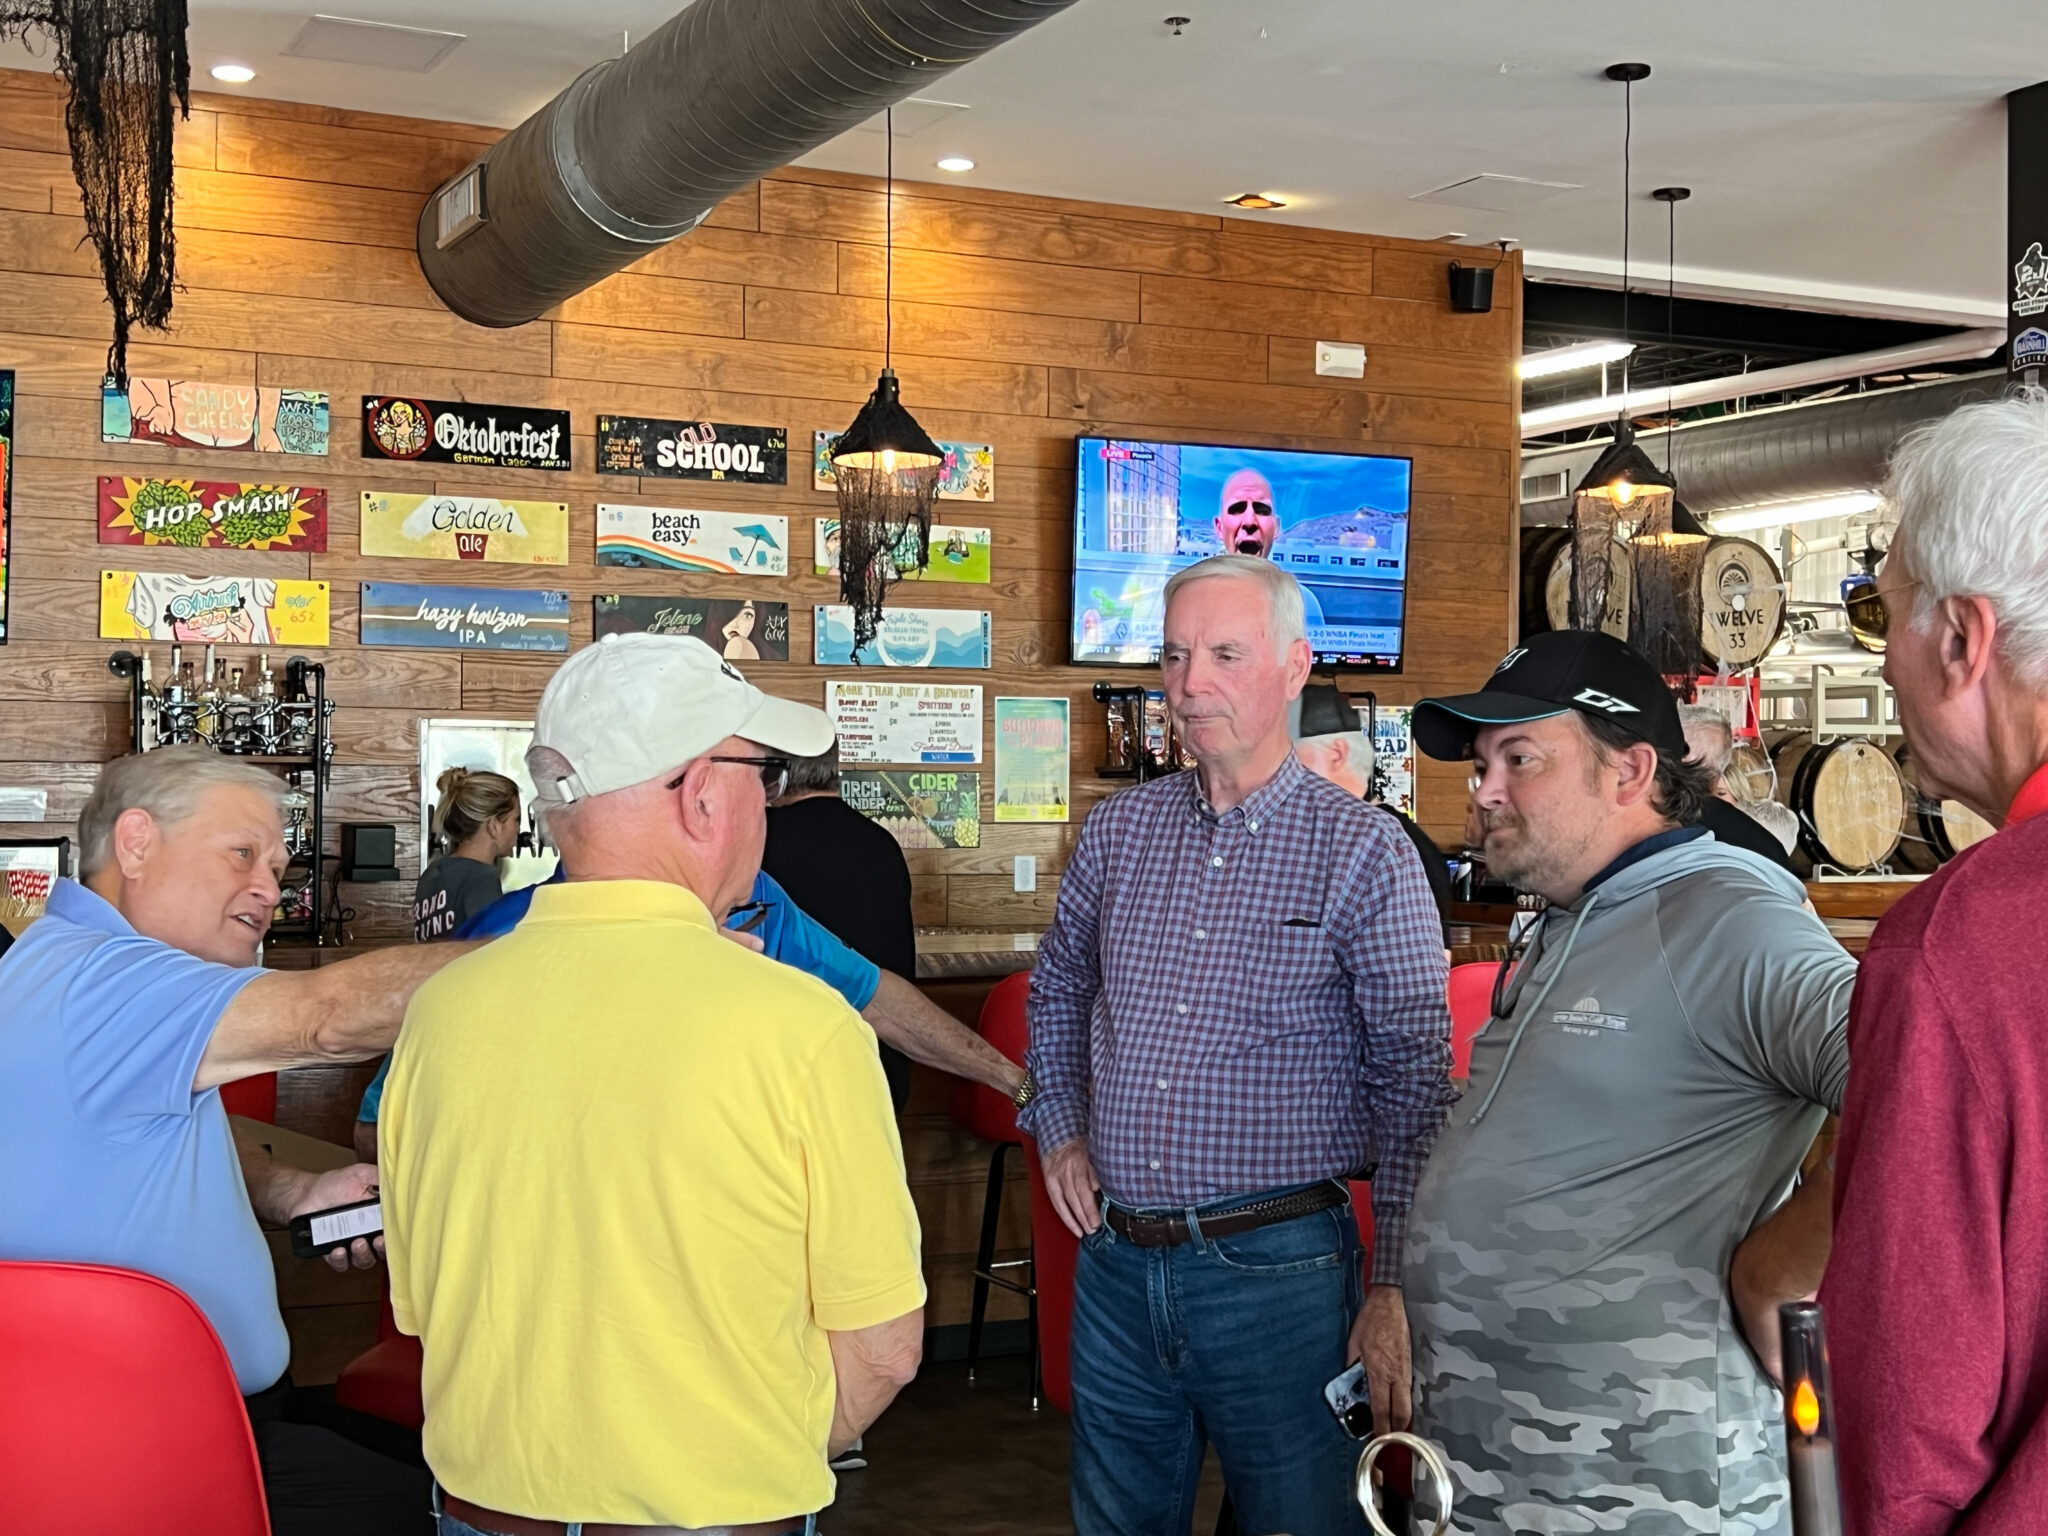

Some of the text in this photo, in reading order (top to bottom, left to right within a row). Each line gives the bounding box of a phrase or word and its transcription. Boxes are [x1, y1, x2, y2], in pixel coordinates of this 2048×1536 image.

[182, 389, 250, 409] SANDY
[185, 411, 252, 431] CHEEKS
[434, 412, 560, 460] Oktoberfest
[680, 422, 716, 446] OLD
[454, 452, 531, 467] German Lager
[657, 439, 765, 473] SCHOOL
[145, 488, 300, 530] HOP SMASH!
[432, 500, 513, 532] Golden
[652, 513, 700, 529] beach
[459, 535, 483, 553] ale
[652, 530, 691, 546] easy
[416, 599, 528, 633] hazy horizon
[647, 607, 703, 633] Jolene
[459, 629, 486, 644] IPA
[1729, 632, 1746, 649] 33
[835, 684, 975, 699] MORE THAN JUST A BREWERY
[1373, 738, 1407, 753] EAD
[842, 780, 881, 798] ORCH
[908, 773, 958, 792] CIDER
[844, 797, 886, 810] NDER
